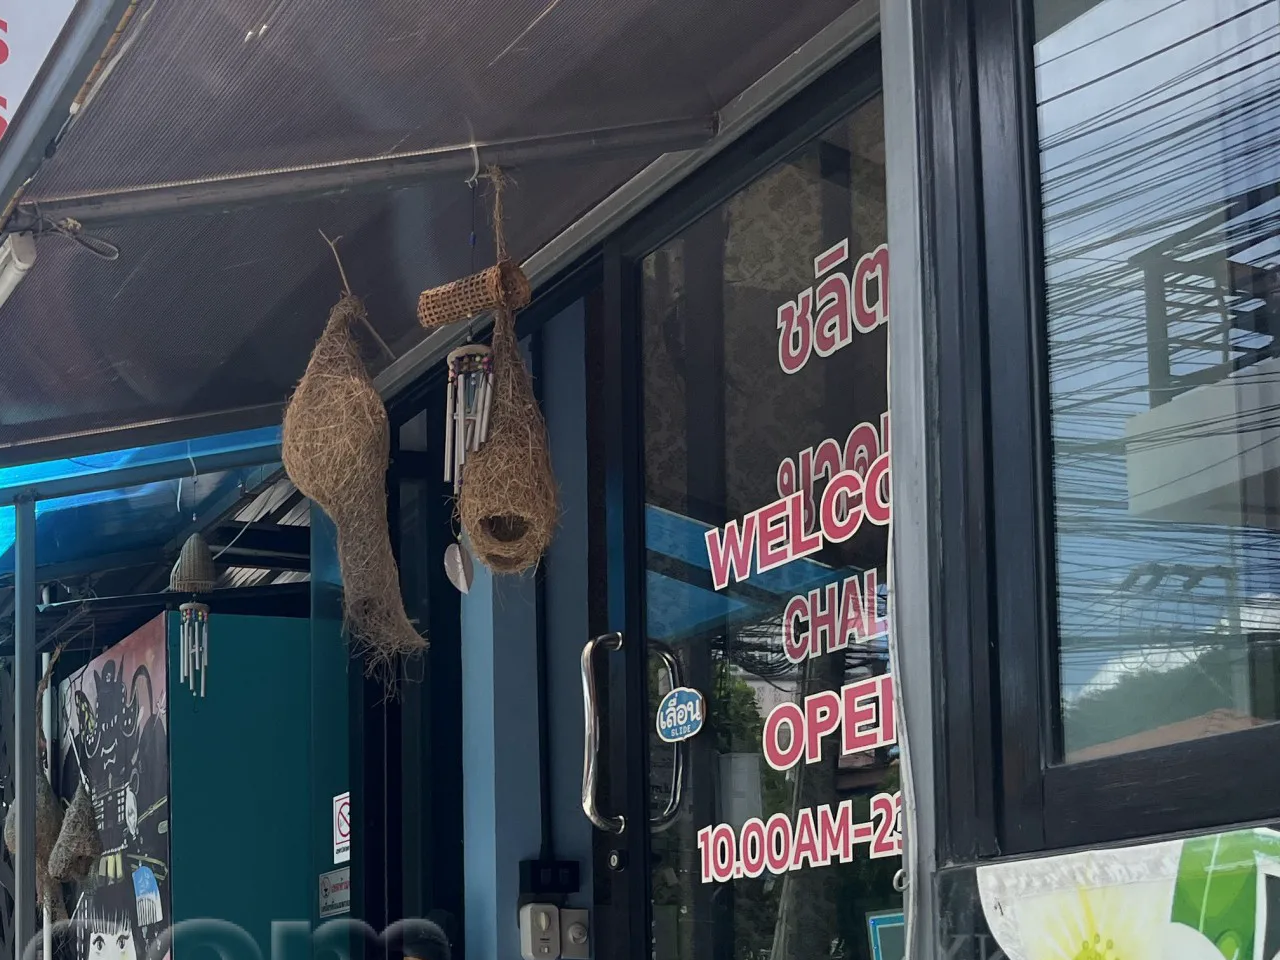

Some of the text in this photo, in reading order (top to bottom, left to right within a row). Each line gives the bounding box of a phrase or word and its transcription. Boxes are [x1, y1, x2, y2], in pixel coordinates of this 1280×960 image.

[660, 693, 701, 729] เลื่อน
[671, 724, 691, 737] SLIDE
[697, 790, 903, 884] 10.00AM-2
